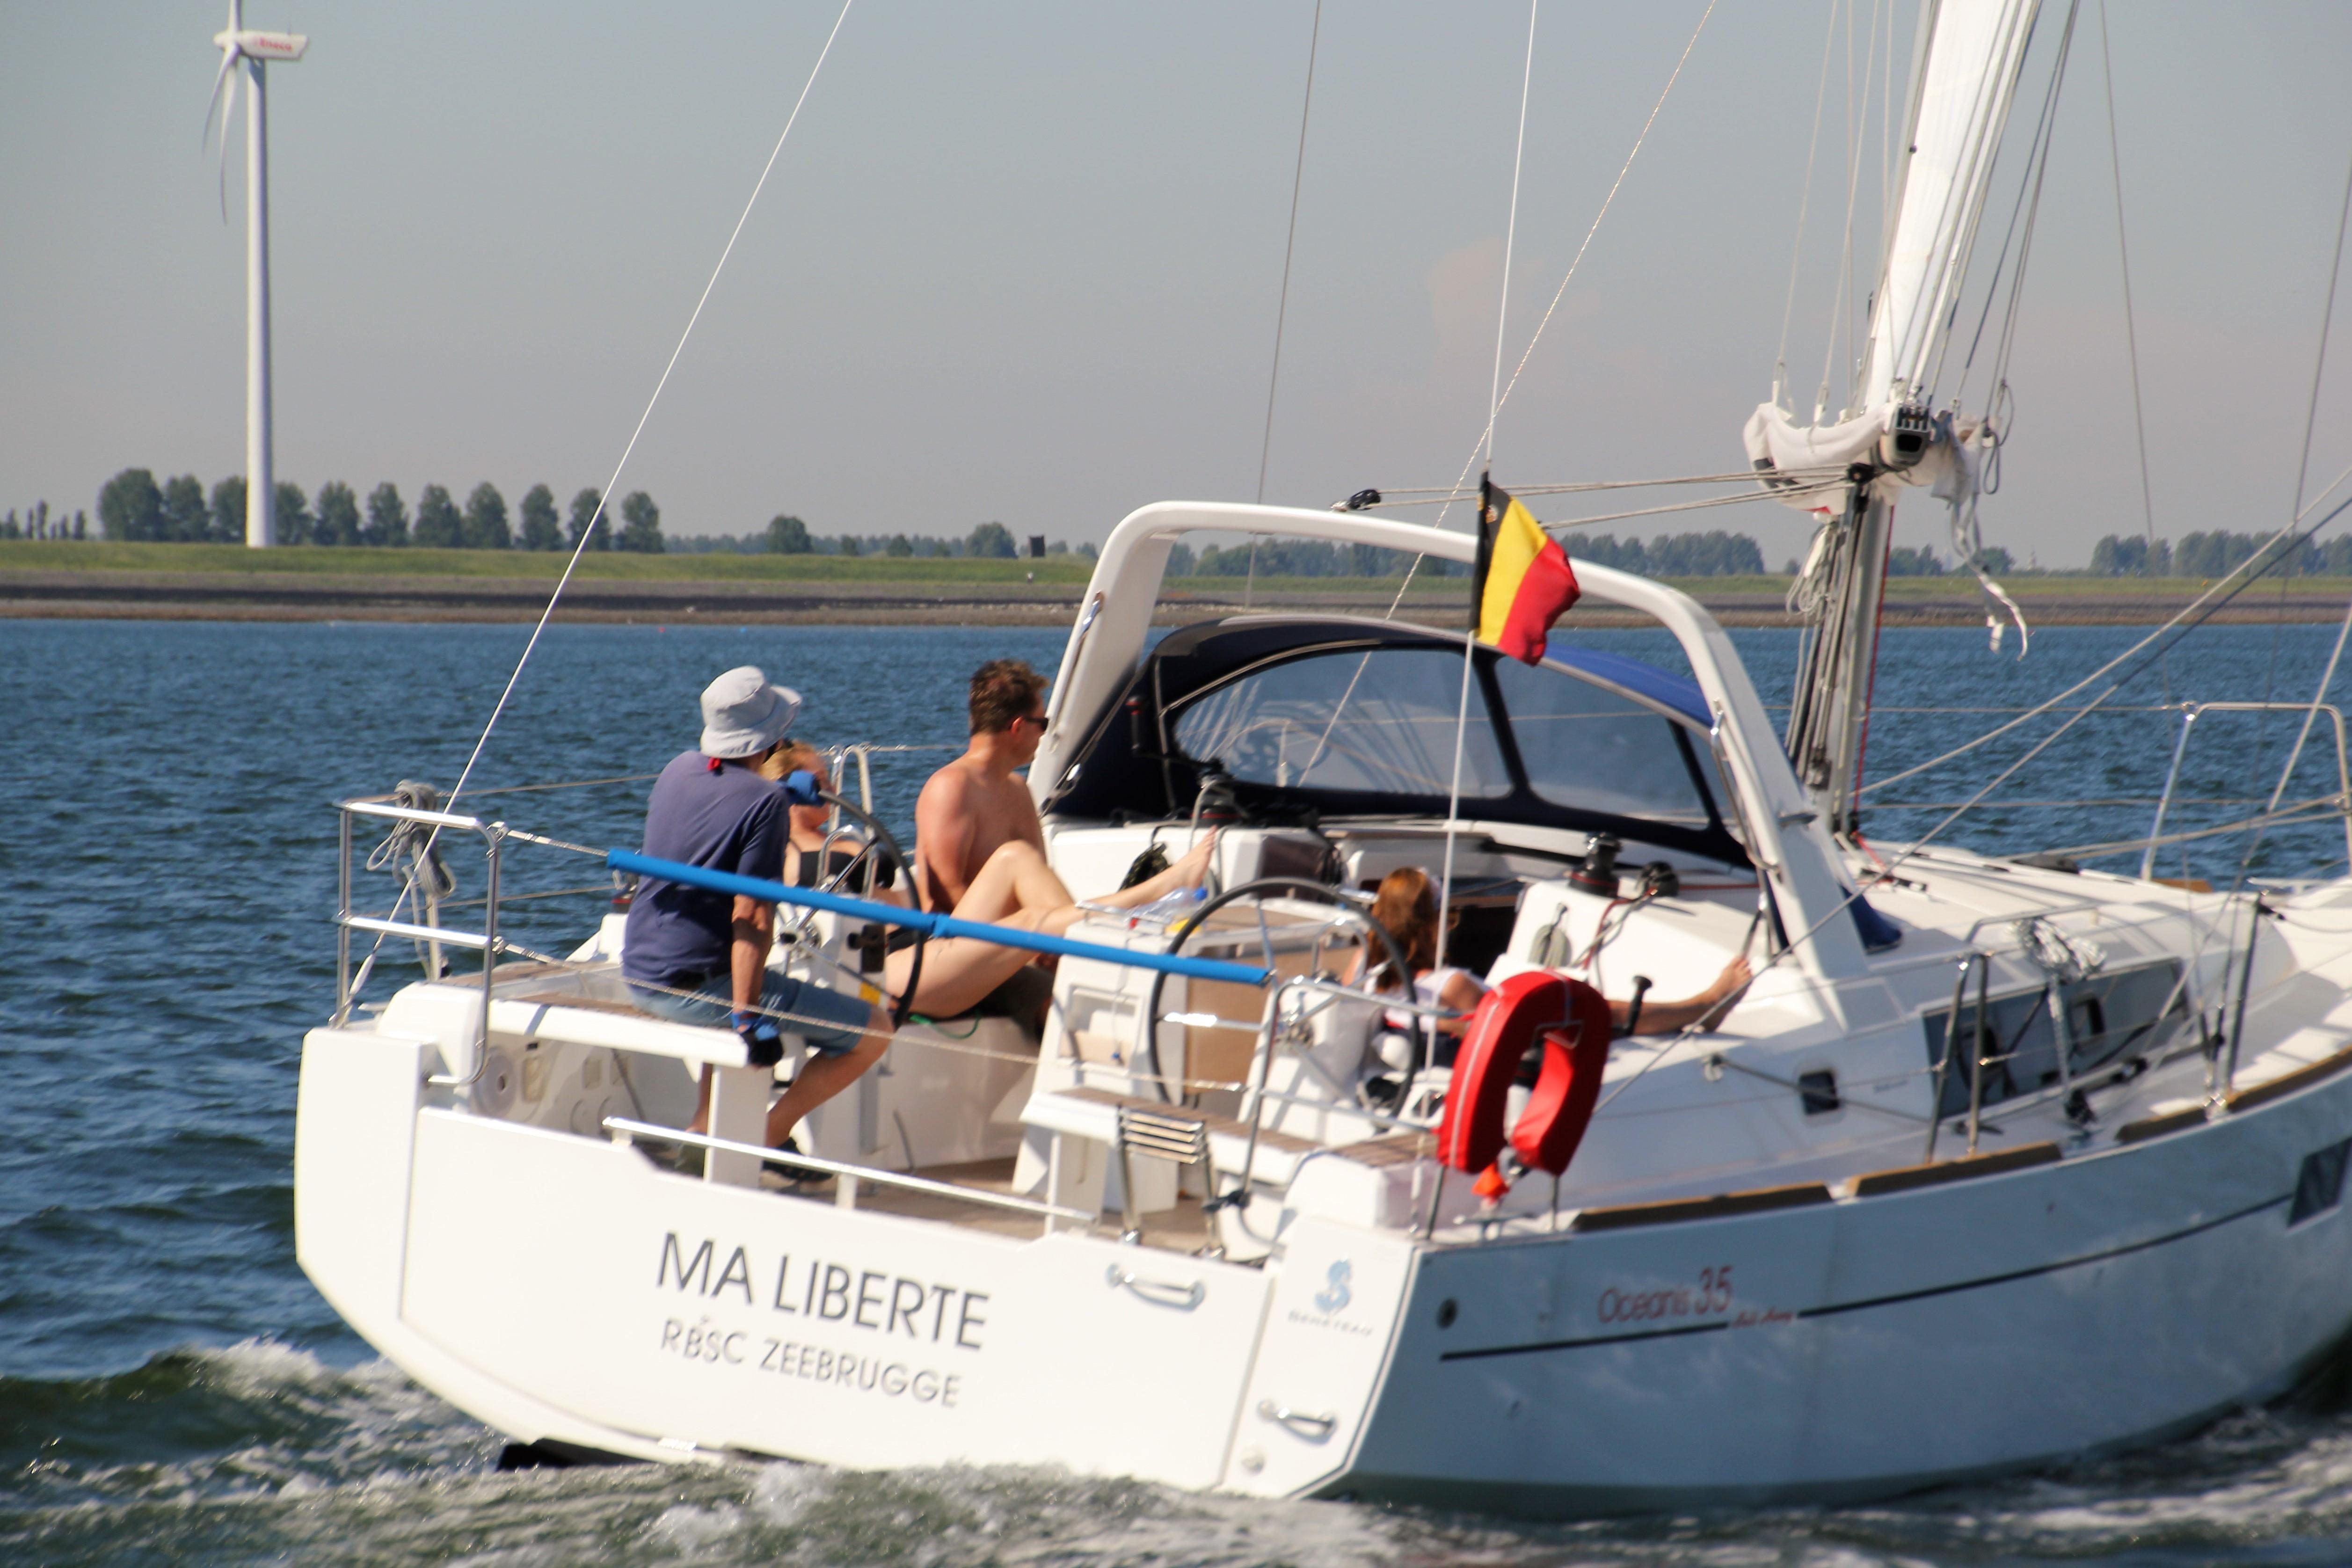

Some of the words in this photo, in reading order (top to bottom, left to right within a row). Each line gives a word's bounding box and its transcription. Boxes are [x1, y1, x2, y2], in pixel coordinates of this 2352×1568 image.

[656, 1232, 754, 1306] MA
[773, 1254, 991, 1350] LIBERTE
[1696, 1266, 1733, 1314] 35
[661, 1318, 746, 1364] RBSC
[760, 1338, 962, 1407] ZEEBRUGGE
